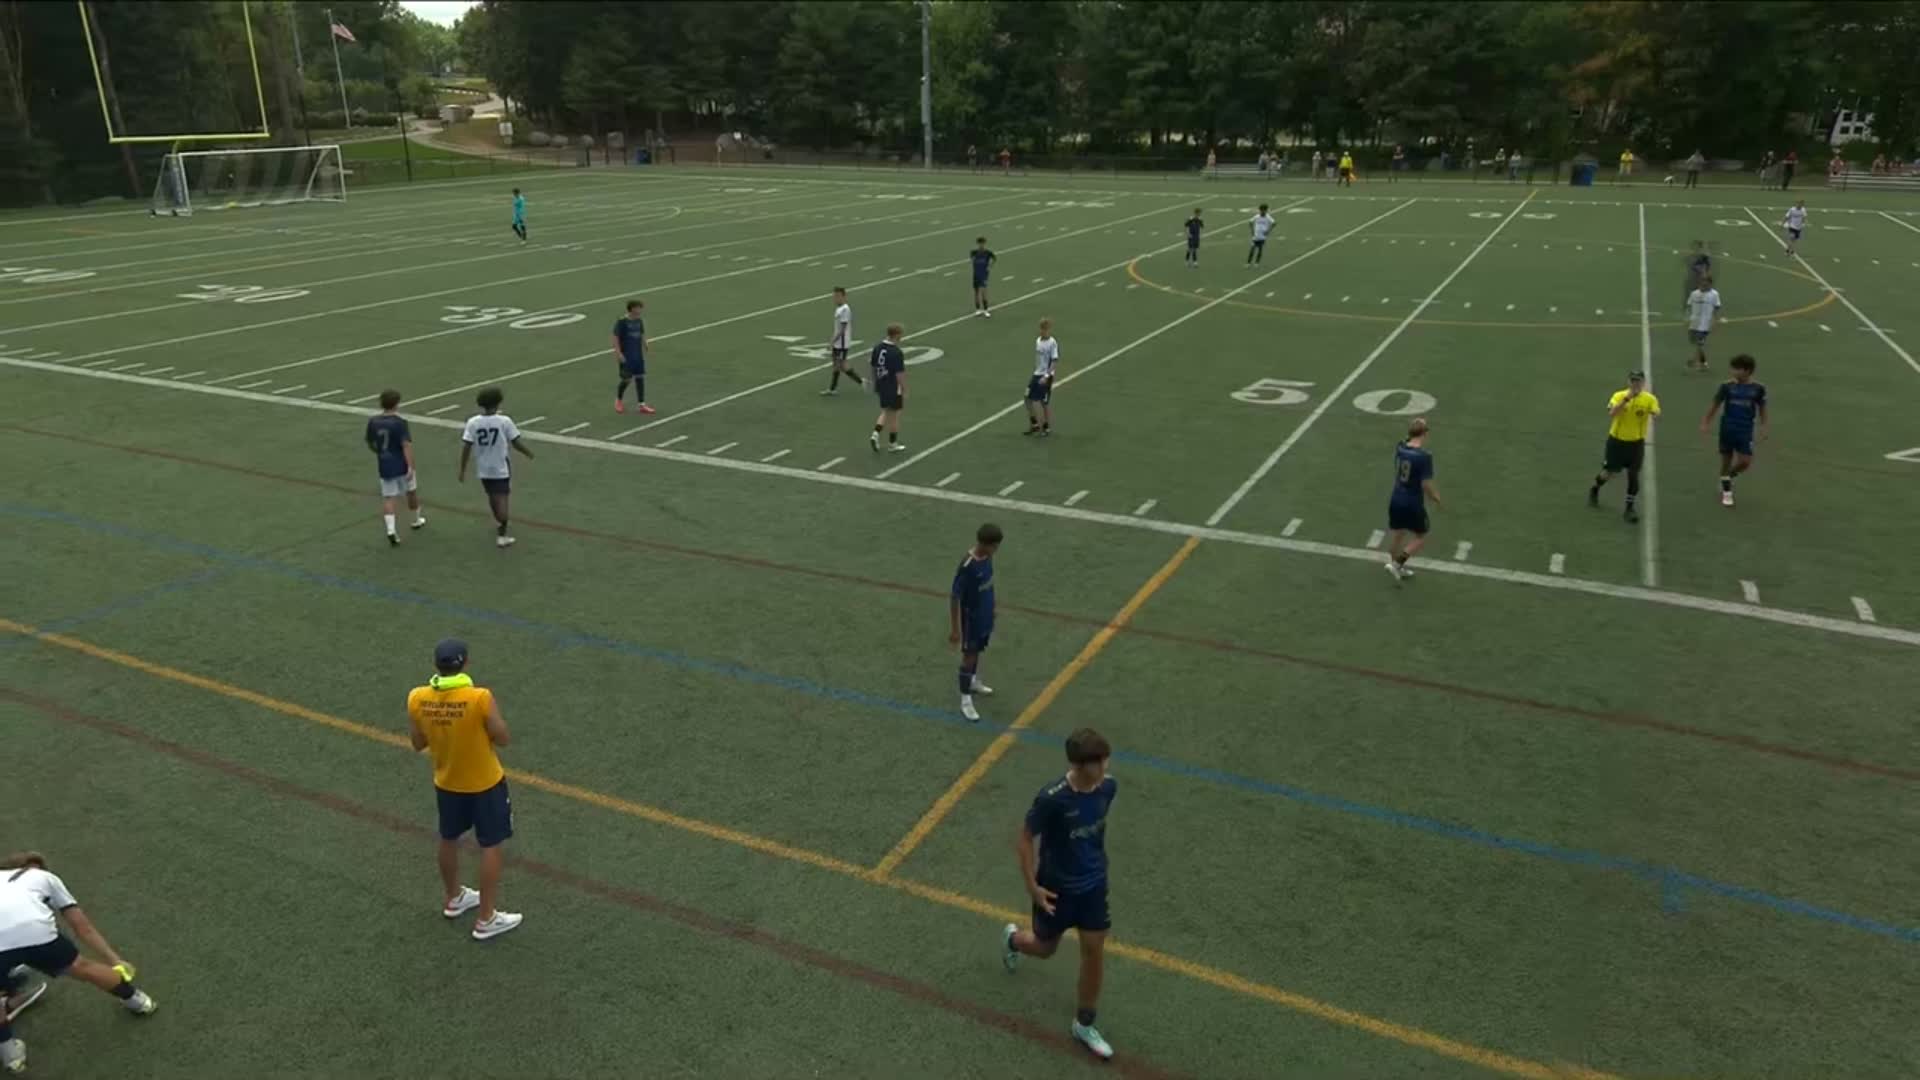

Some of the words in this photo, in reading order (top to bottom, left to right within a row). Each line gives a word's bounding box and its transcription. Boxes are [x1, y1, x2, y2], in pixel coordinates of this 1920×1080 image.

[440, 306, 587, 329] 30
[877, 349, 887, 366] 6
[1230, 378, 1438, 415] 50
[377, 428, 391, 449] 7
[476, 428, 499, 446] 27
